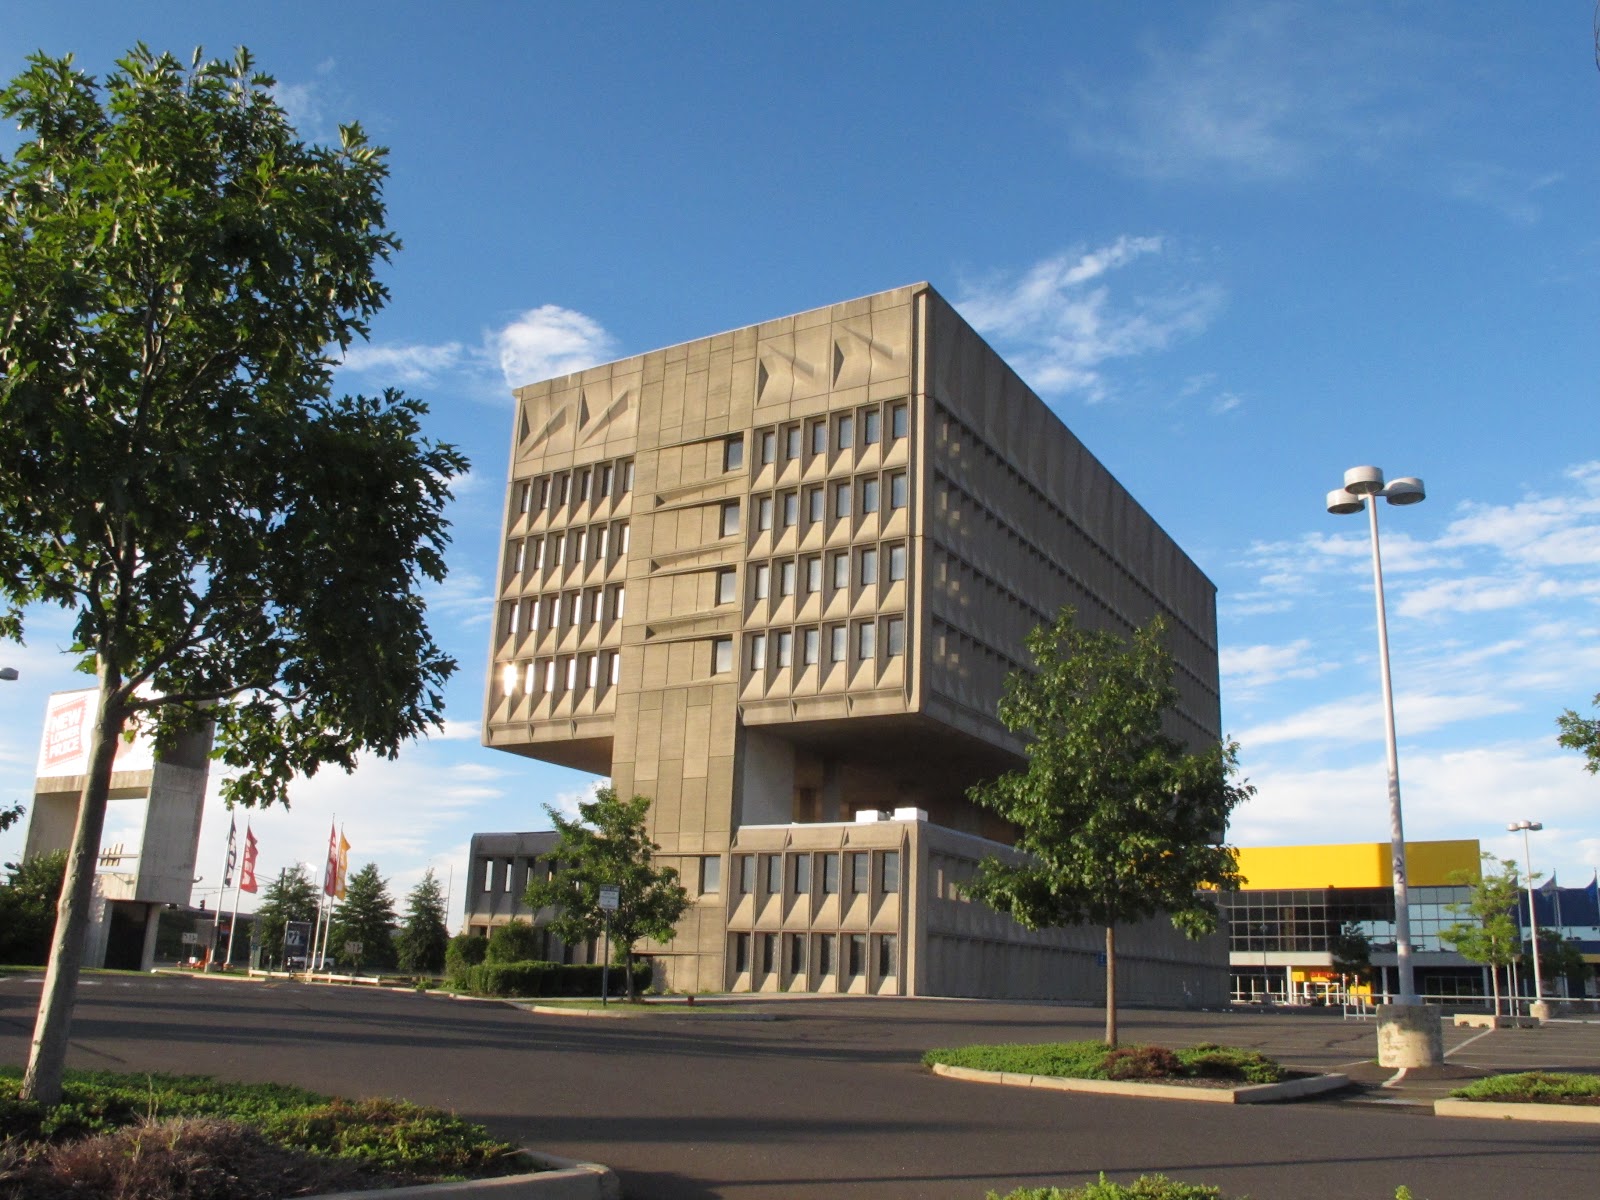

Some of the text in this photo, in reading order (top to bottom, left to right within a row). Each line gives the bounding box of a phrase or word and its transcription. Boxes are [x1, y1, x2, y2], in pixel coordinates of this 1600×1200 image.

[50, 708, 82, 731] NEW
[50, 725, 80, 744] LOWER
[49, 738, 80, 758] PRICE
